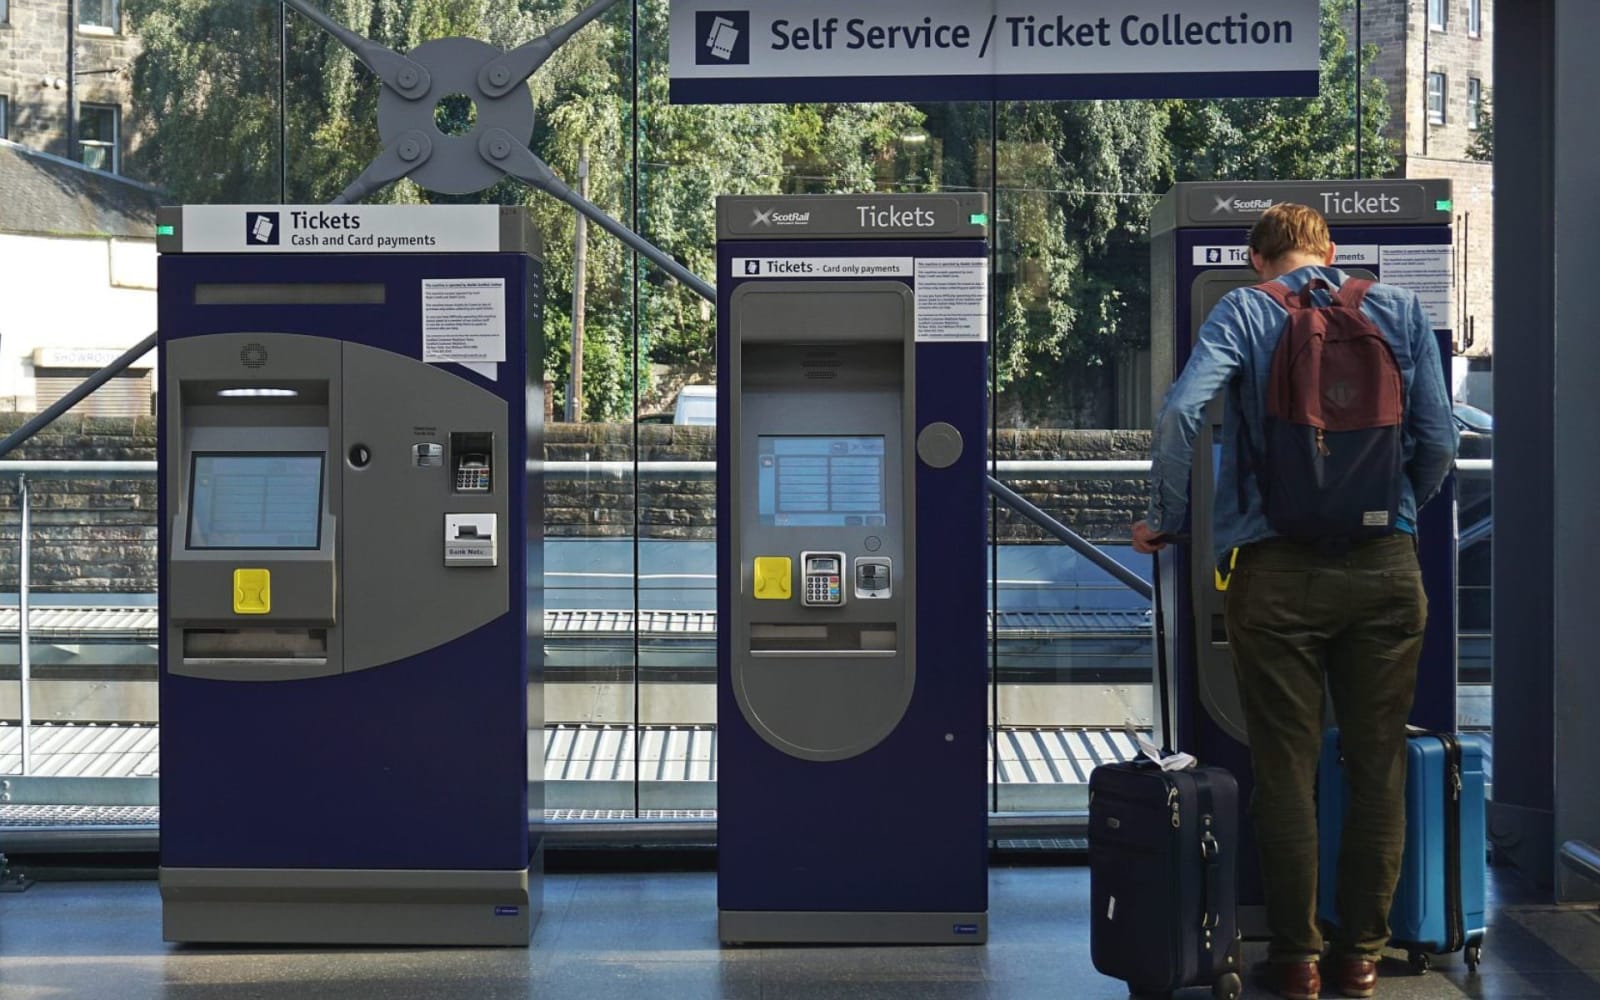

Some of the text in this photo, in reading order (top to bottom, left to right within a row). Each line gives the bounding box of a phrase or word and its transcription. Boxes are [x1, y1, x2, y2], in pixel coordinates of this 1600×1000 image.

[771, 12, 1292, 58] Self Service / Ticket Collection
[1320, 191, 1400, 214] Tickets
[290, 211, 360, 229] Tickets
[771, 211, 810, 222] ScotRail
[857, 205, 935, 227] Tickets
[291, 234, 436, 248] Cash and Card payments
[766, 260, 813, 273] Tickets
[823, 265, 840, 273] Card
[842, 265, 859, 274] only
[861, 265, 900, 275] payments
